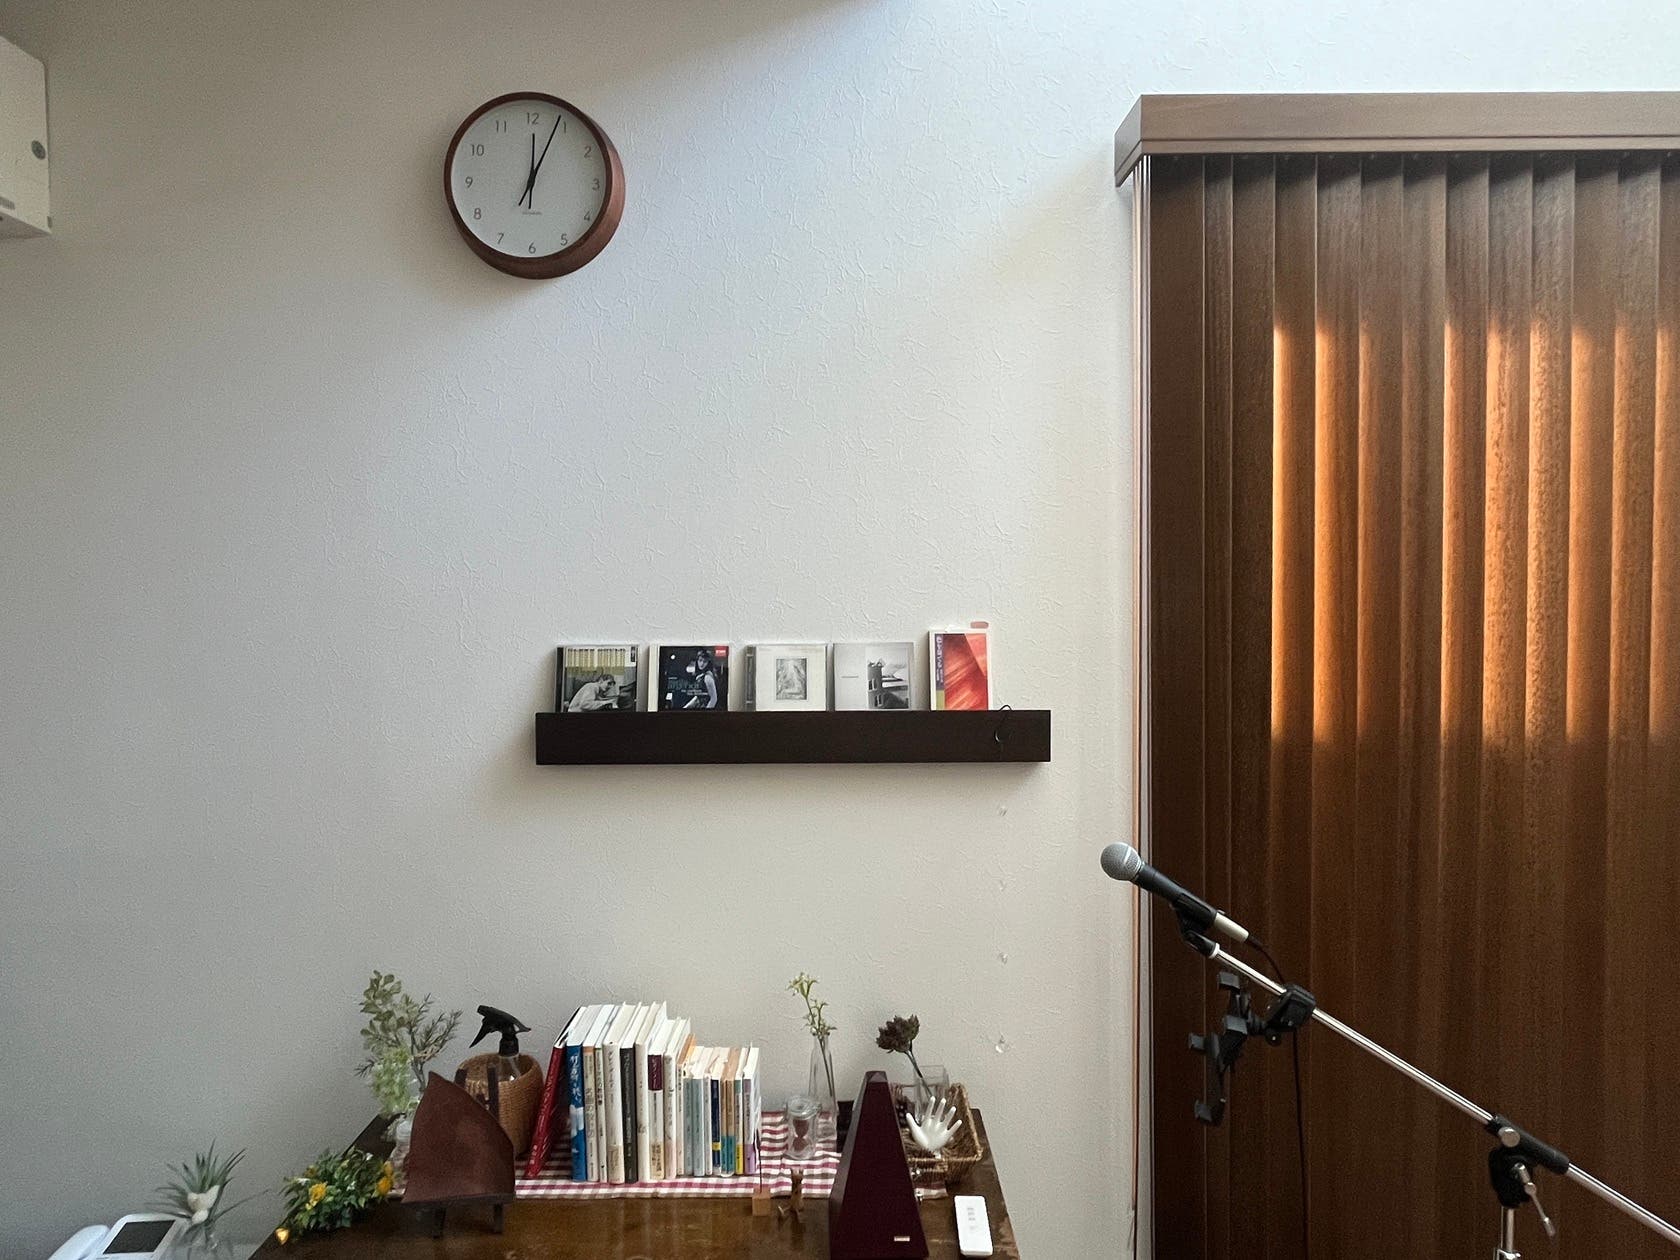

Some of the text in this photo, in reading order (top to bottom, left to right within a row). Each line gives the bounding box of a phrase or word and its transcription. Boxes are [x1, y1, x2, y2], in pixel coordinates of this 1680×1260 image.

[526, 112, 539, 125] 12
[495, 120, 507, 133] 11
[470, 144, 485, 157] 10
[583, 146, 592, 158] 2
[464, 176, 473, 189] 9
[592, 178, 601, 191] 3
[473, 207, 482, 220] 8
[583, 210, 591, 222] 4
[496, 232, 505, 245] 7
[560, 233, 569, 247] 5
[527, 242, 536, 255] 6
